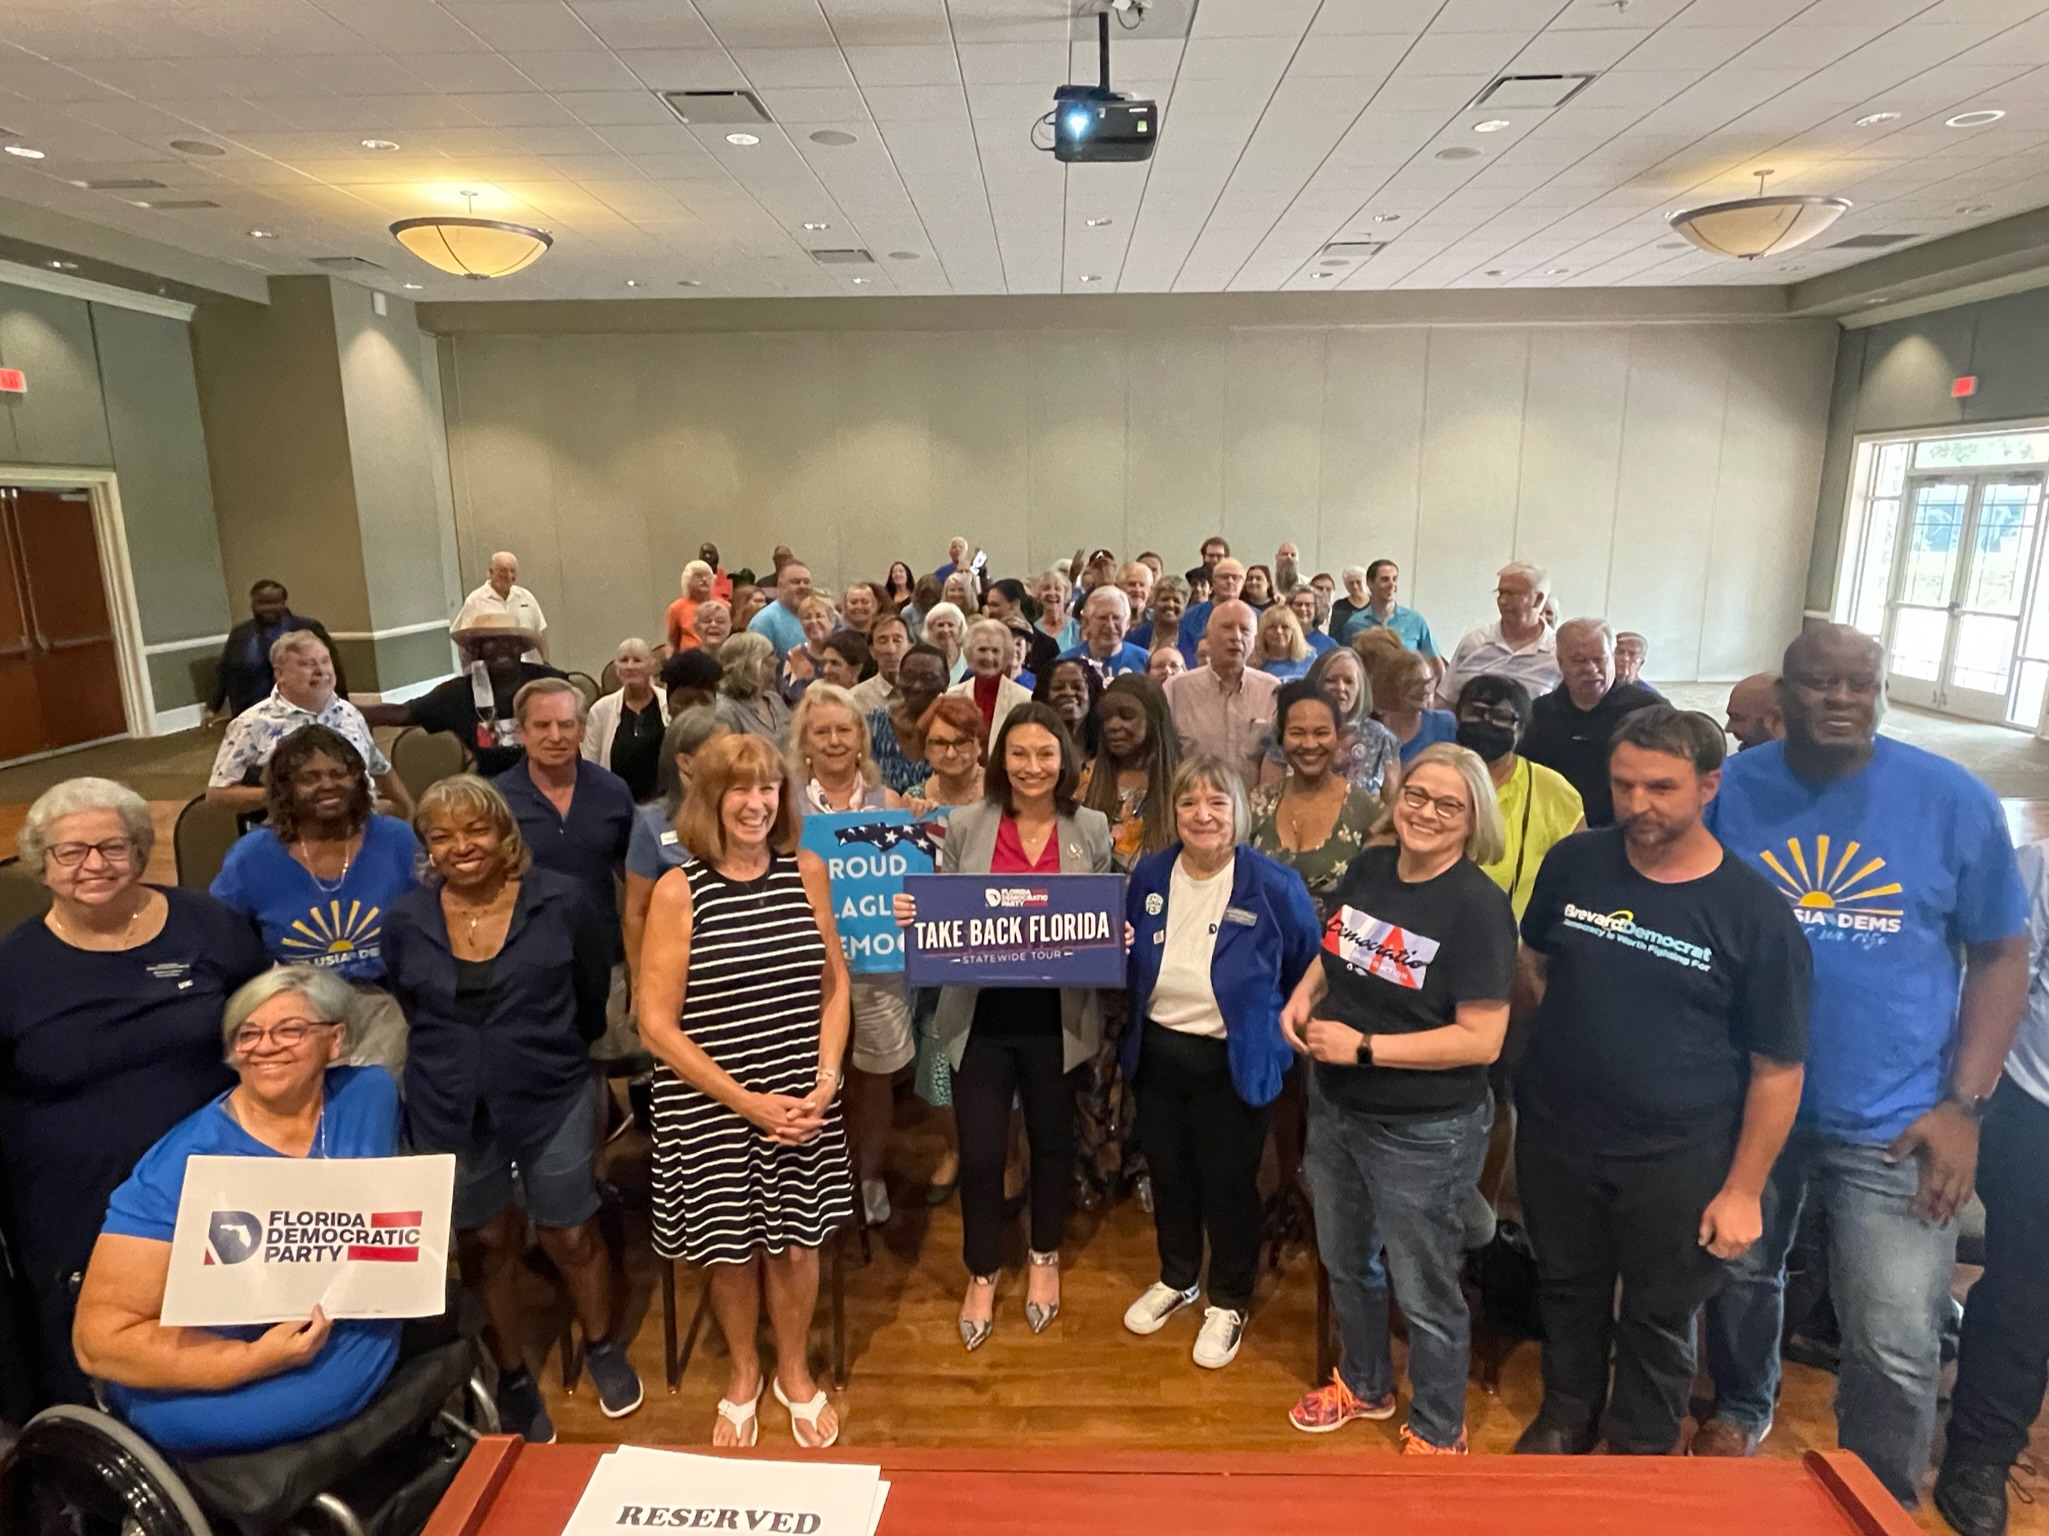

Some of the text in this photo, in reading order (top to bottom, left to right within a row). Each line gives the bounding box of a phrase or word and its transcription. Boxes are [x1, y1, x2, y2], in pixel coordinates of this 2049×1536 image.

[828, 854, 908, 881] ROUD
[914, 911, 1110, 950] TAKE BACK FLORIDA
[1837, 913, 1902, 933] DEMS
[840, 932, 905, 961] EMO
[961, 950, 1061, 965] STATEWIDE TOUR
[268, 1210, 366, 1228] FLORIDA
[266, 1228, 421, 1246] DEMOCRATIC
[264, 1245, 344, 1264] PARTY
[615, 1505, 822, 1535] RESERVED
